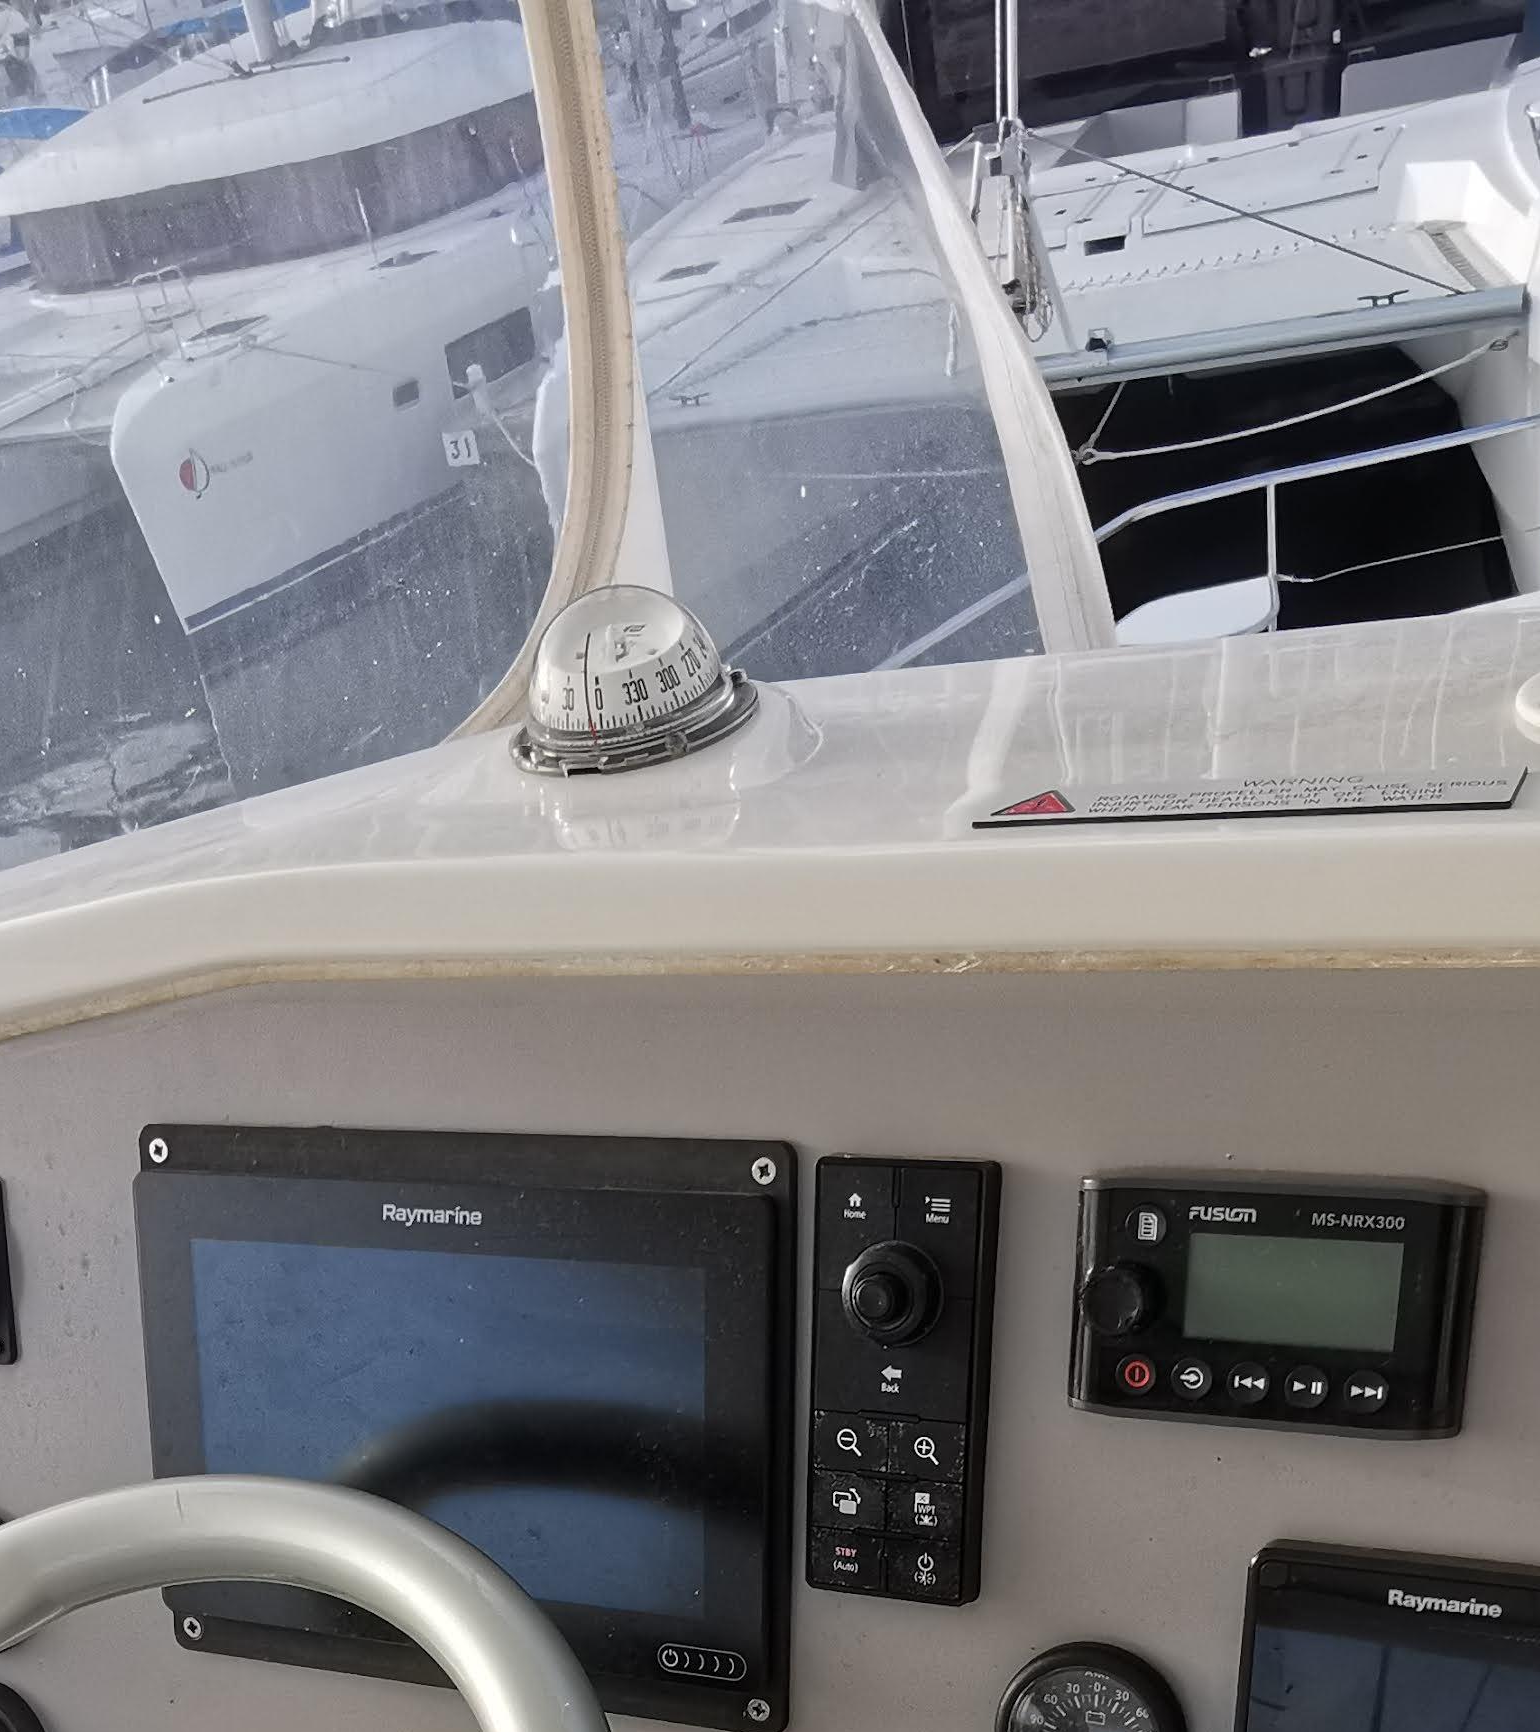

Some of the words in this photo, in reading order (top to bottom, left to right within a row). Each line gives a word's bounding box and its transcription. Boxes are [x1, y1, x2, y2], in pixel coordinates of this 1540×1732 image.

[655, 664, 680, 694] 300
[622, 678, 649, 706] 330
[1244, 776, 1363, 787] WARNING
[382, 1203, 483, 1227] Raymarine
[843, 1208, 867, 1220] Home
[925, 1213, 950, 1224] Menu
[1311, 1211, 1406, 1232] MS-NRX300
[881, 1382, 900, 1394] Back
[918, 1504, 936, 1515] WPT
[835, 1546, 858, 1558] STBY
[1387, 1588, 1503, 1619] Raymarine
[1065, 1682, 1080, 1694] 30
[1043, 1694, 1058, 1705] 60
[1115, 1690, 1130, 1702] 30
